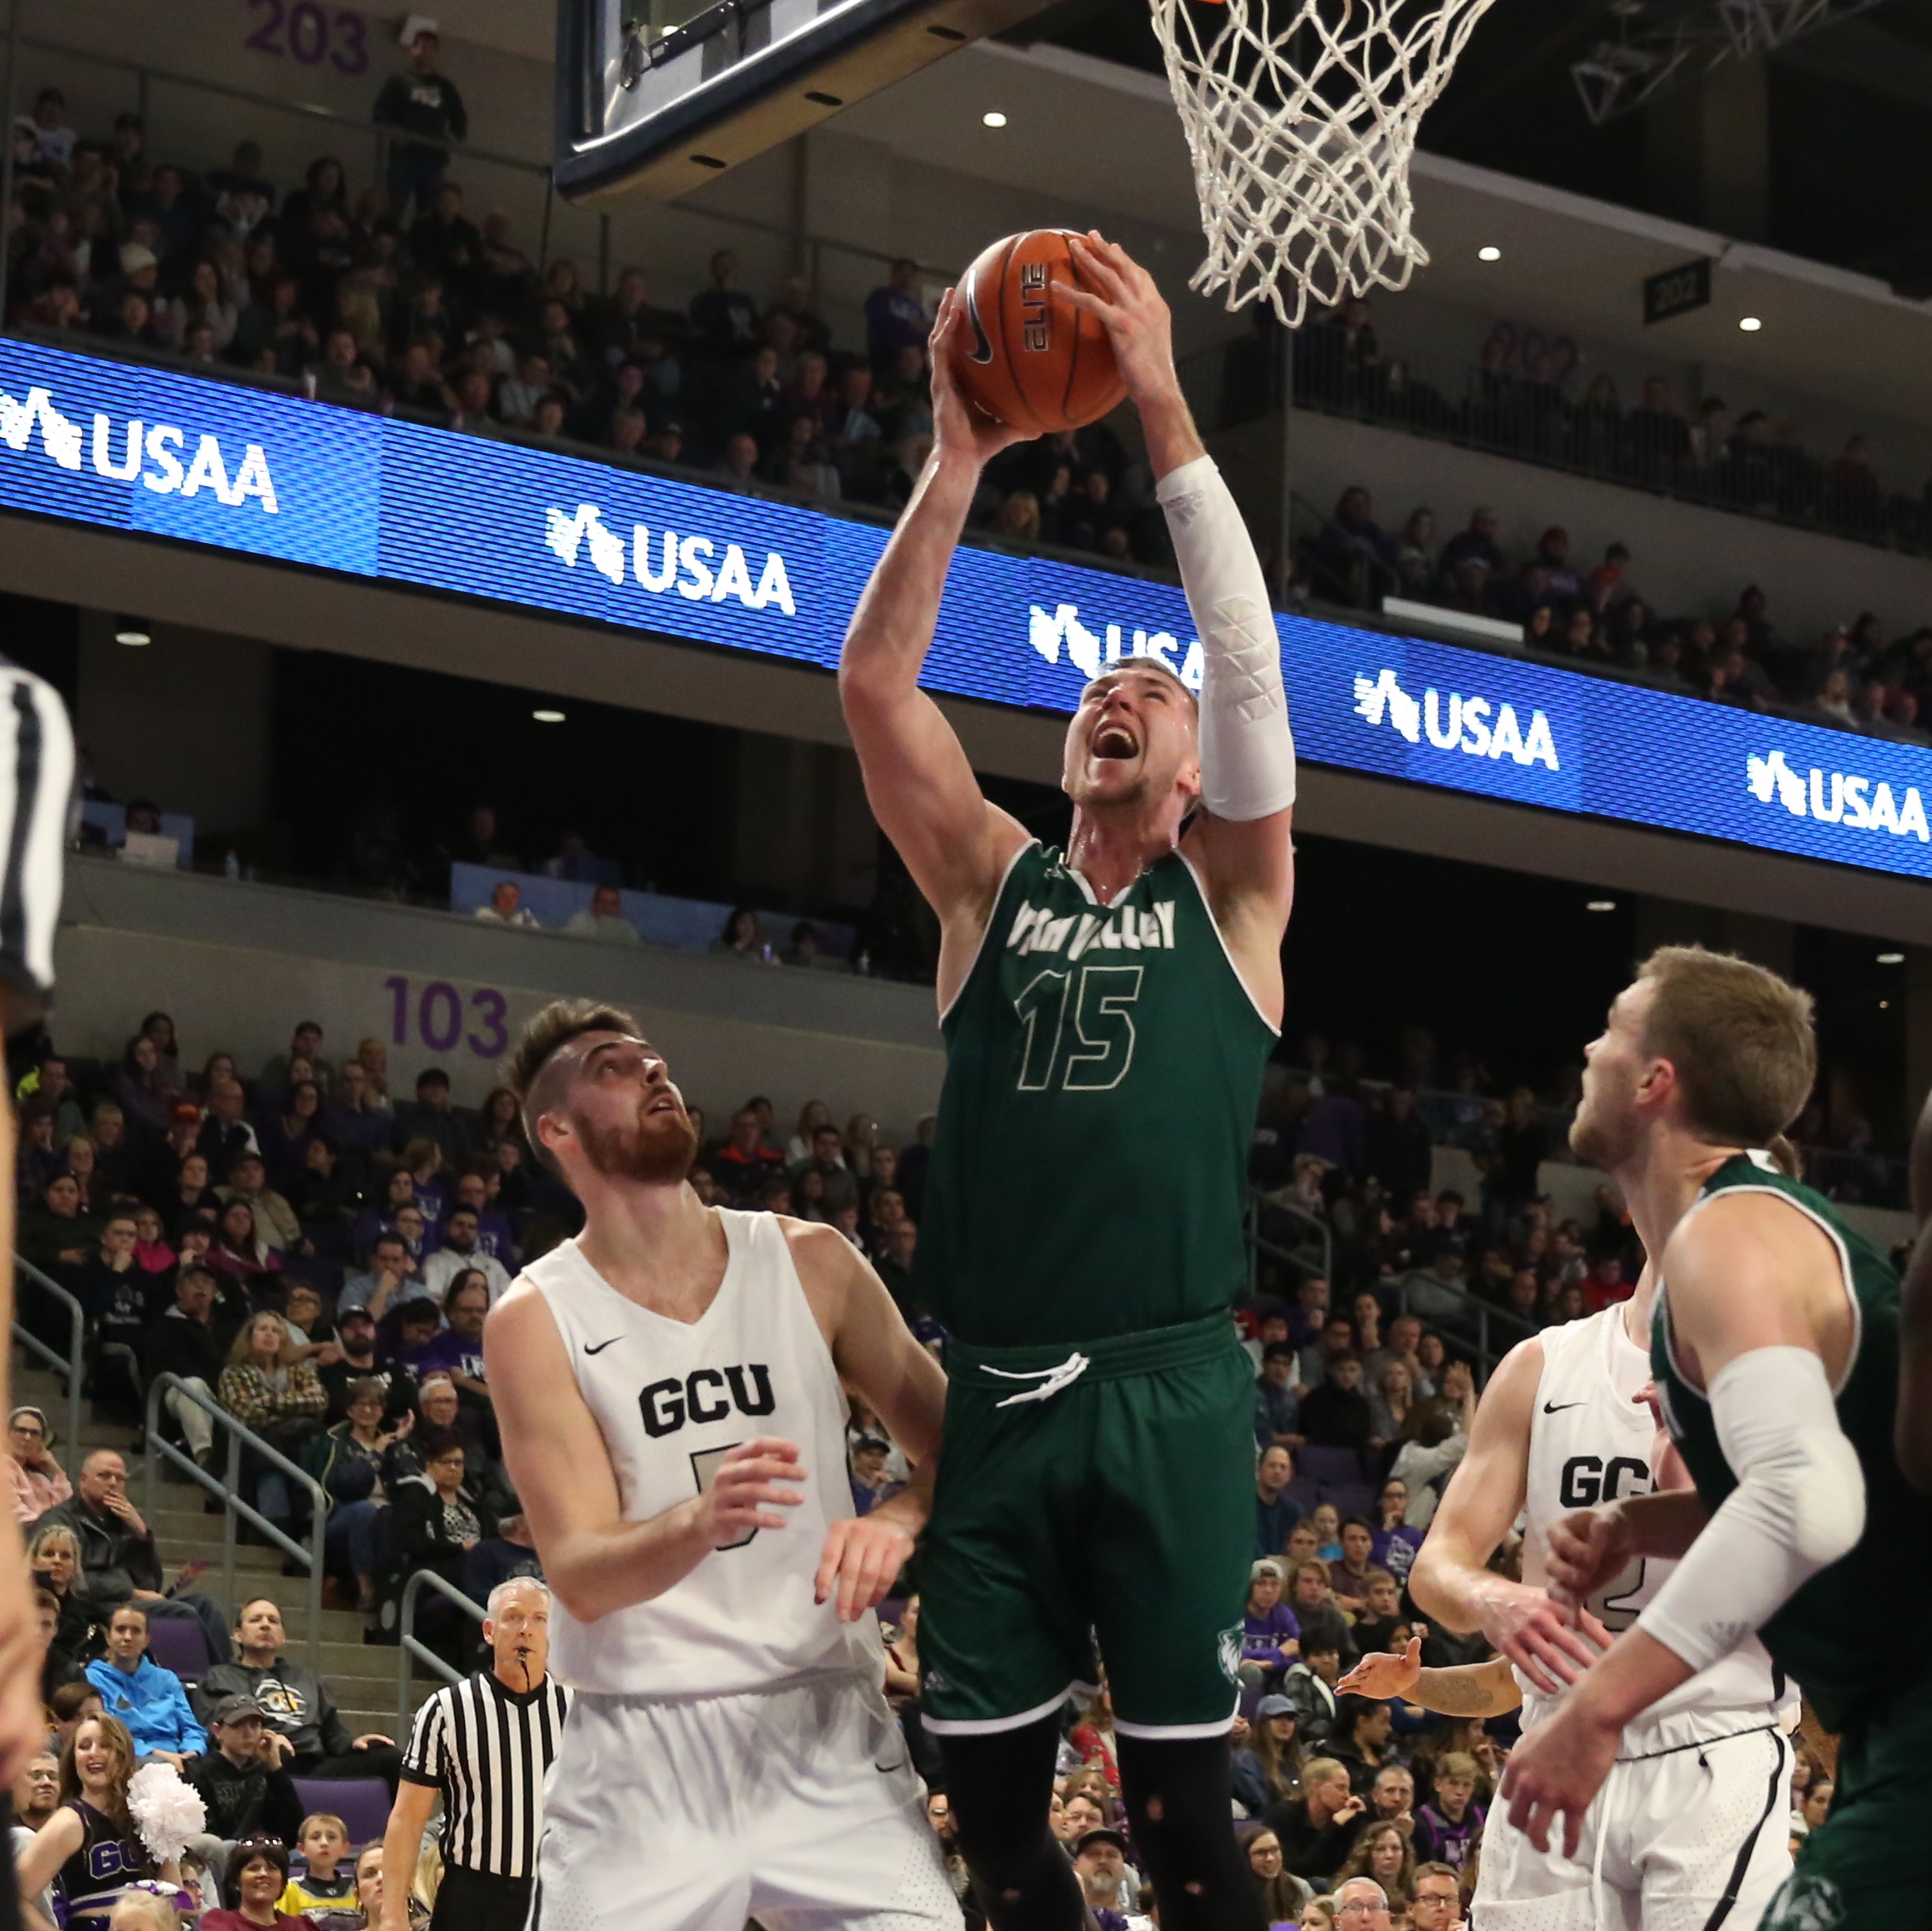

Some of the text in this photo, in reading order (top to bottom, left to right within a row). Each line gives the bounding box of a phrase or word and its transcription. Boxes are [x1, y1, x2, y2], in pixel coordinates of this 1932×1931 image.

[245, 0, 369, 76] 203
[1022, 263, 1049, 352] ELITE
[92, 413, 279, 514] USAA
[631, 524, 797, 616] USAA
[1105, 623, 1204, 689] USA
[1423, 688, 1560, 771] USAA
[1809, 768, 1931, 843] USAA
[384, 976, 509, 1059] 103
[1013, 966, 1145, 1091] 15
[639, 1364, 776, 1438] GCU
[1560, 1456, 1655, 1508] GC
[89, 1840, 153, 1881] GC
